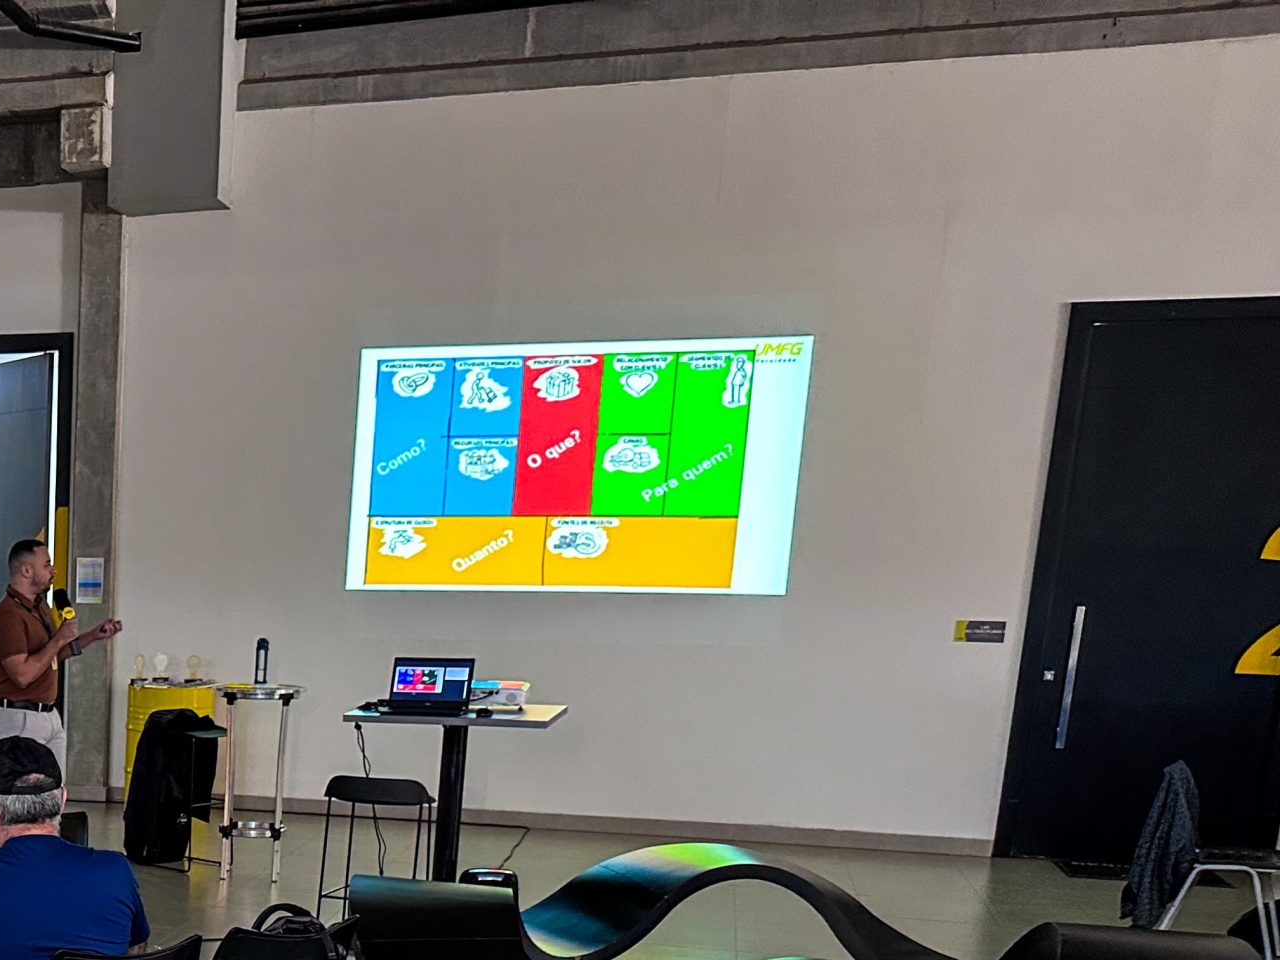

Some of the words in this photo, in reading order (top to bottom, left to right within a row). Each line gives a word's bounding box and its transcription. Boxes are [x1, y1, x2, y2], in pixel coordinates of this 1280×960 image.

[376, 438, 427, 476] Como?
[526, 453, 542, 468] O
[545, 429, 582, 460] que?
[640, 477, 679, 503] Para
[682, 443, 734, 482] quem?
[451, 529, 514, 572] Quanto?
